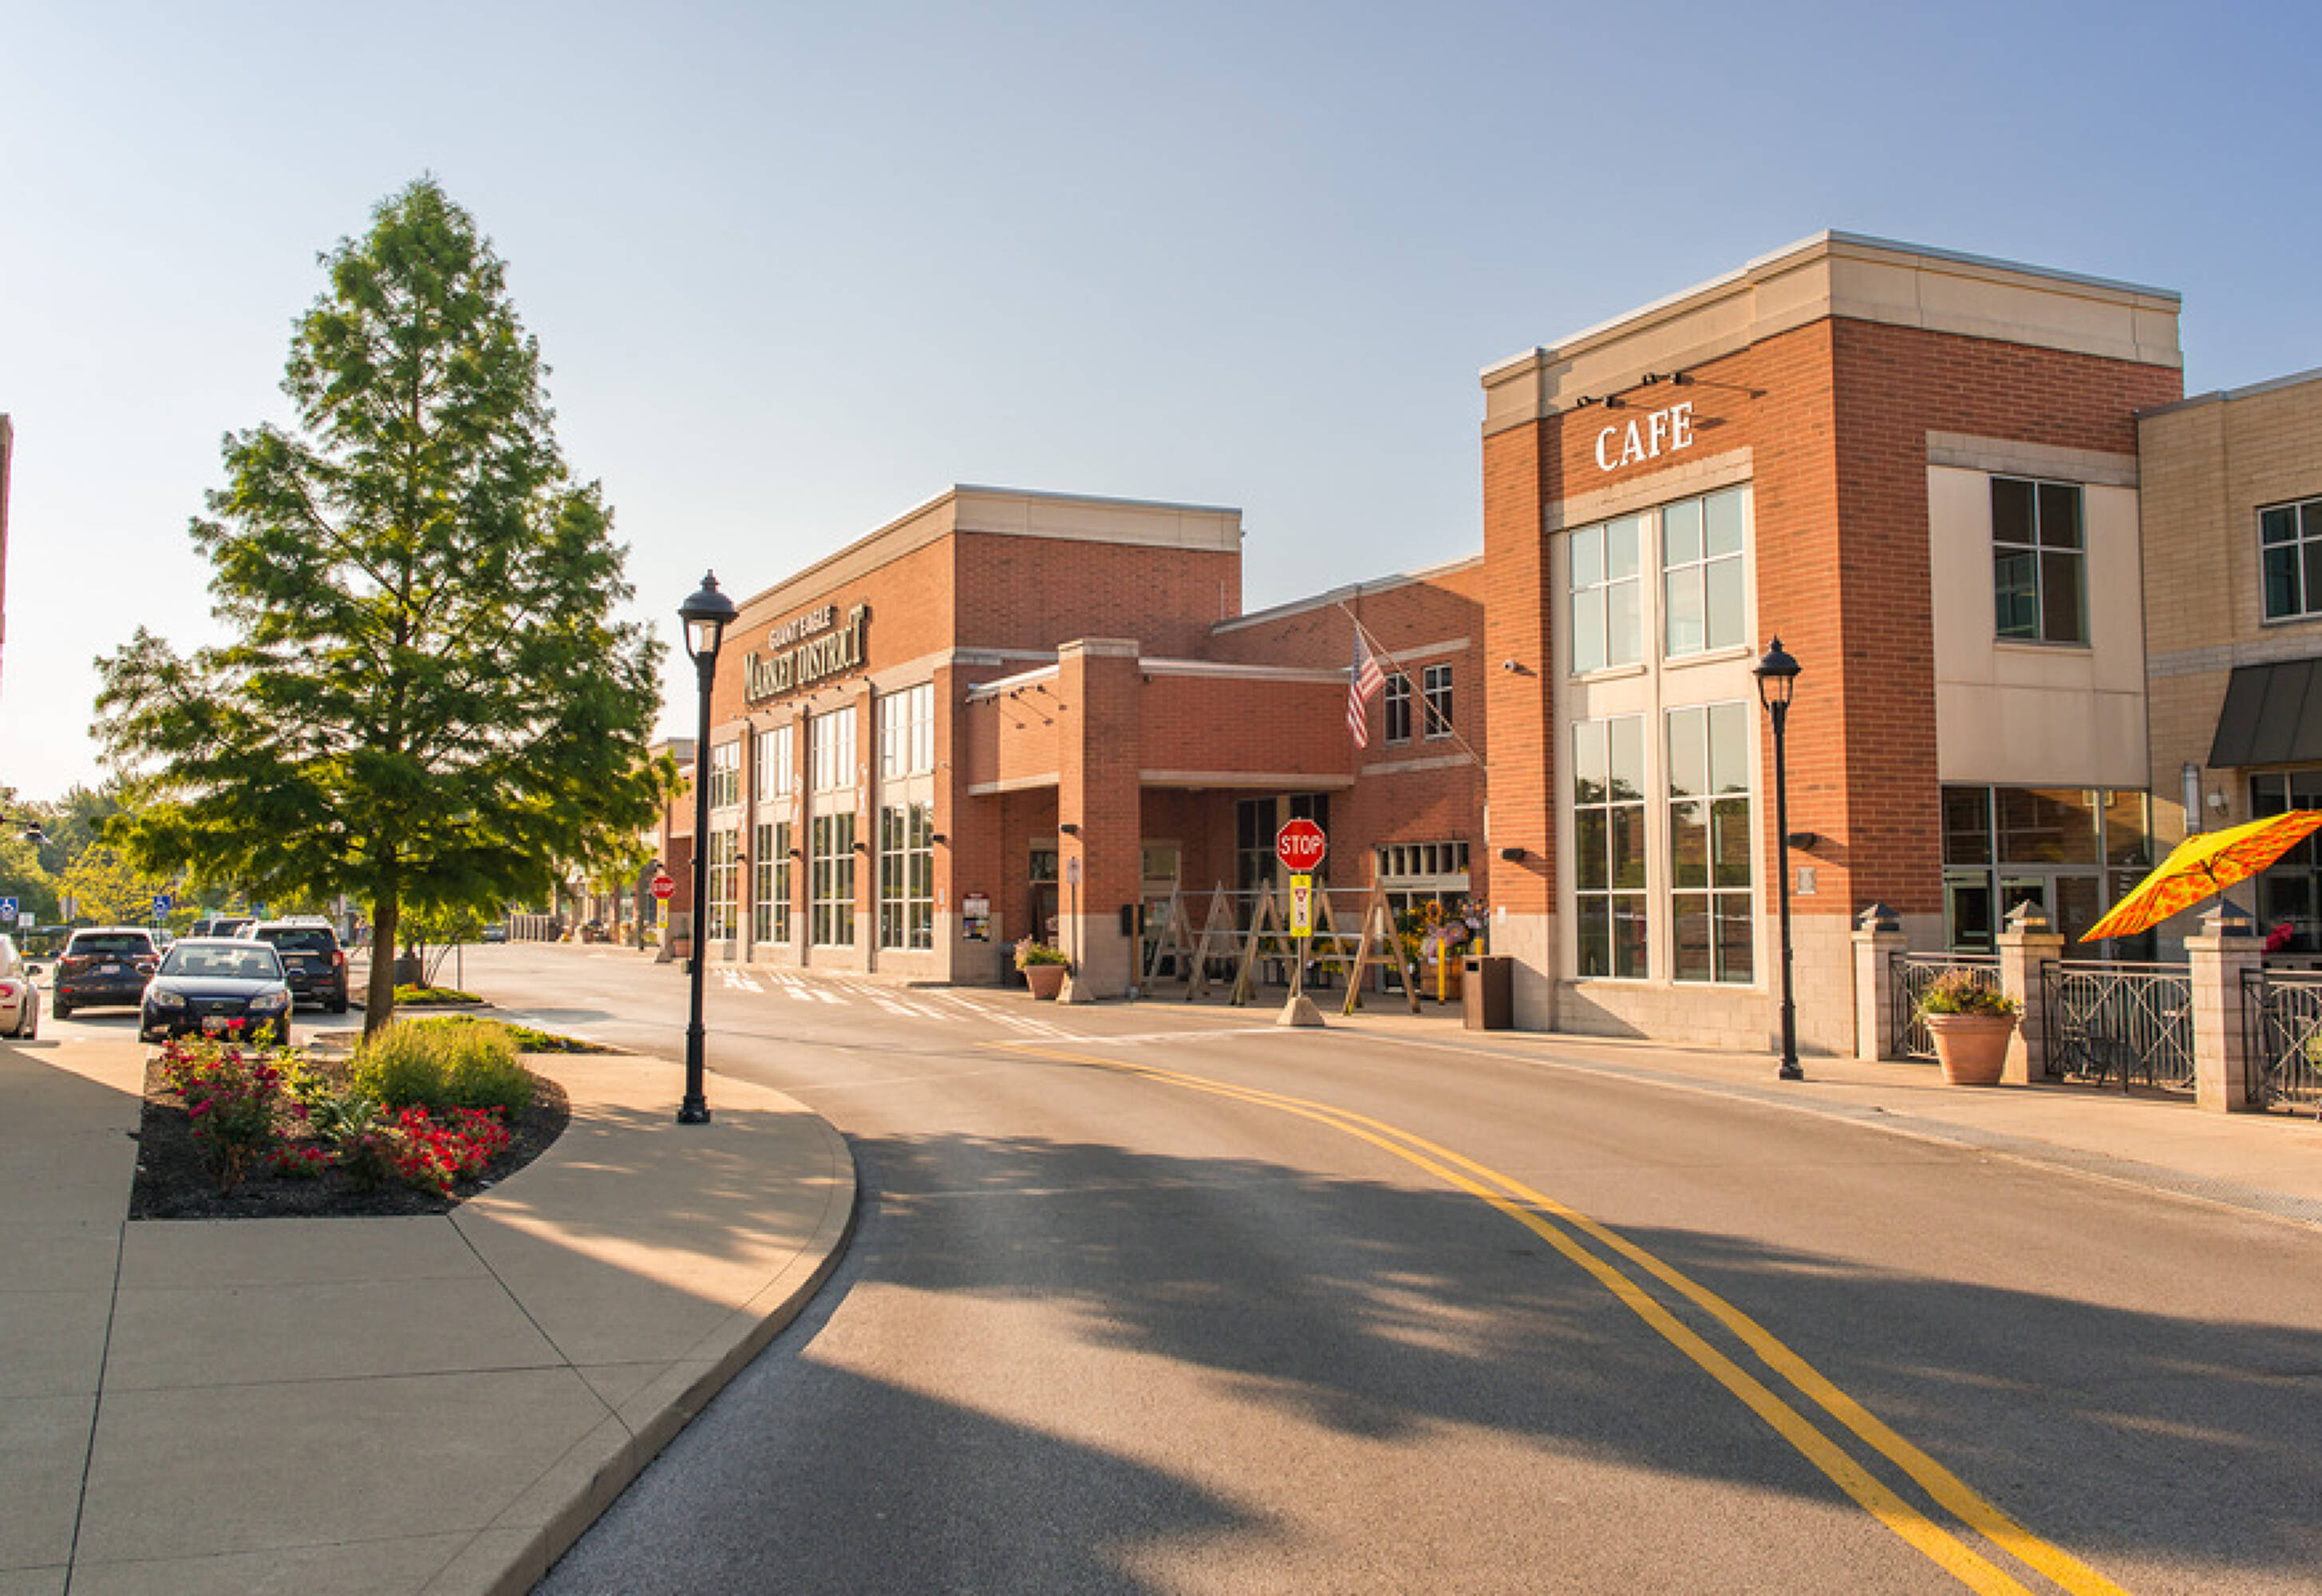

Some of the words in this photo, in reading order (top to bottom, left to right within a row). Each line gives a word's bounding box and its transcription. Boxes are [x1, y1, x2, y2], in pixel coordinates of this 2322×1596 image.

[1596, 401, 1692, 471] CAFE
[800, 605, 832, 637] EAGLE
[744, 650, 795, 701] MARKET
[798, 603, 865, 684] DISTRICT
[1281, 835, 1322, 855] STOP
